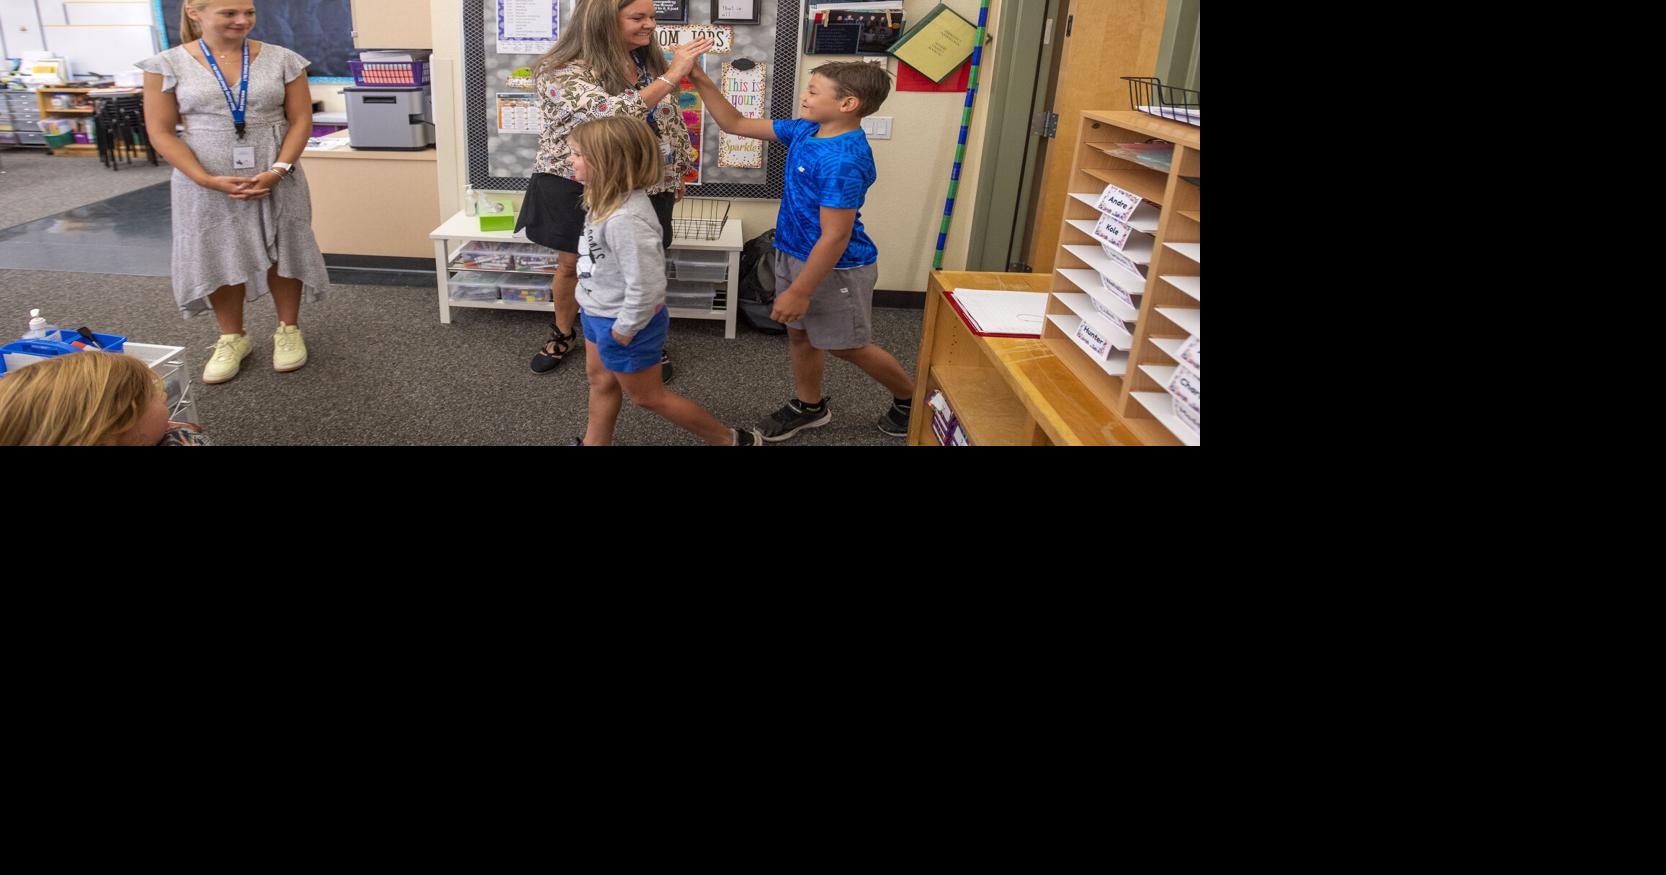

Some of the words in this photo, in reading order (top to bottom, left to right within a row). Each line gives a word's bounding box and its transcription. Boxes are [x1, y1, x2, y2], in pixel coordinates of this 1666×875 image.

[727, 78, 748, 92] This
[752, 80, 760, 92] is
[731, 95, 756, 108] your
[1108, 196, 1128, 209] Andre
[1105, 223, 1119, 235] Kole
[1083, 325, 1104, 344] Hunter
